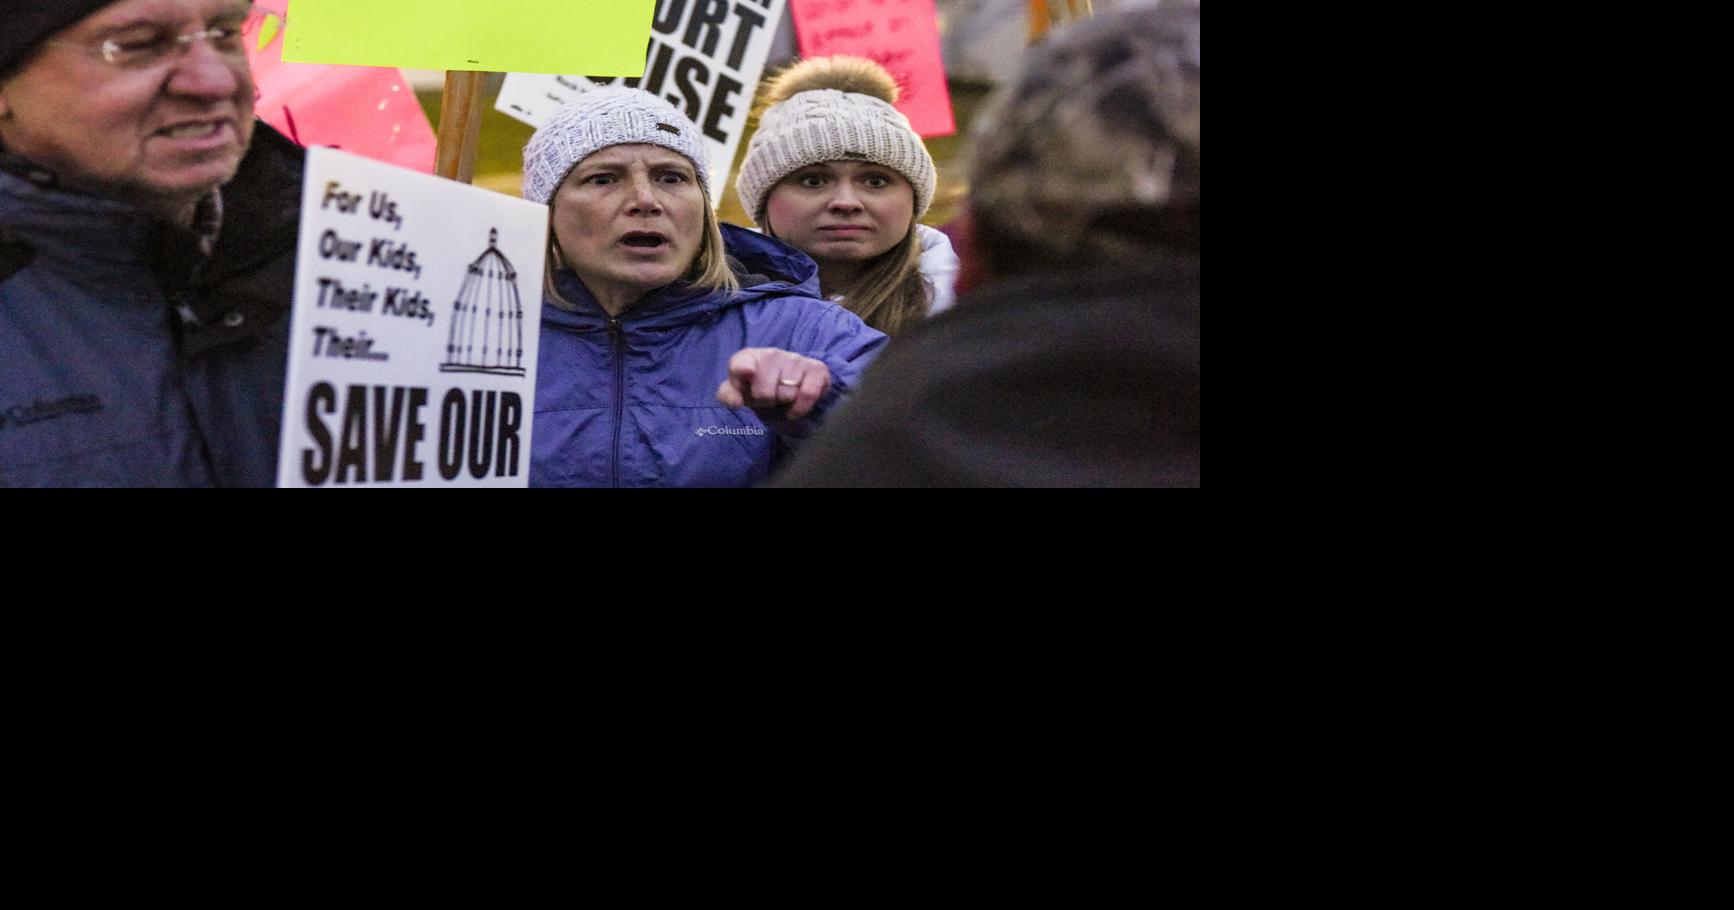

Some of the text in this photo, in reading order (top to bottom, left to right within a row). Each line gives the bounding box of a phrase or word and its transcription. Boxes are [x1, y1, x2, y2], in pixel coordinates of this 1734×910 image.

[320, 181, 402, 230] For Us,
[319, 230, 421, 278] Our Kids,
[316, 278, 435, 326] Their Kids,
[302, 381, 522, 486] SAVE OUR
[707, 425, 764, 436] Columbia
